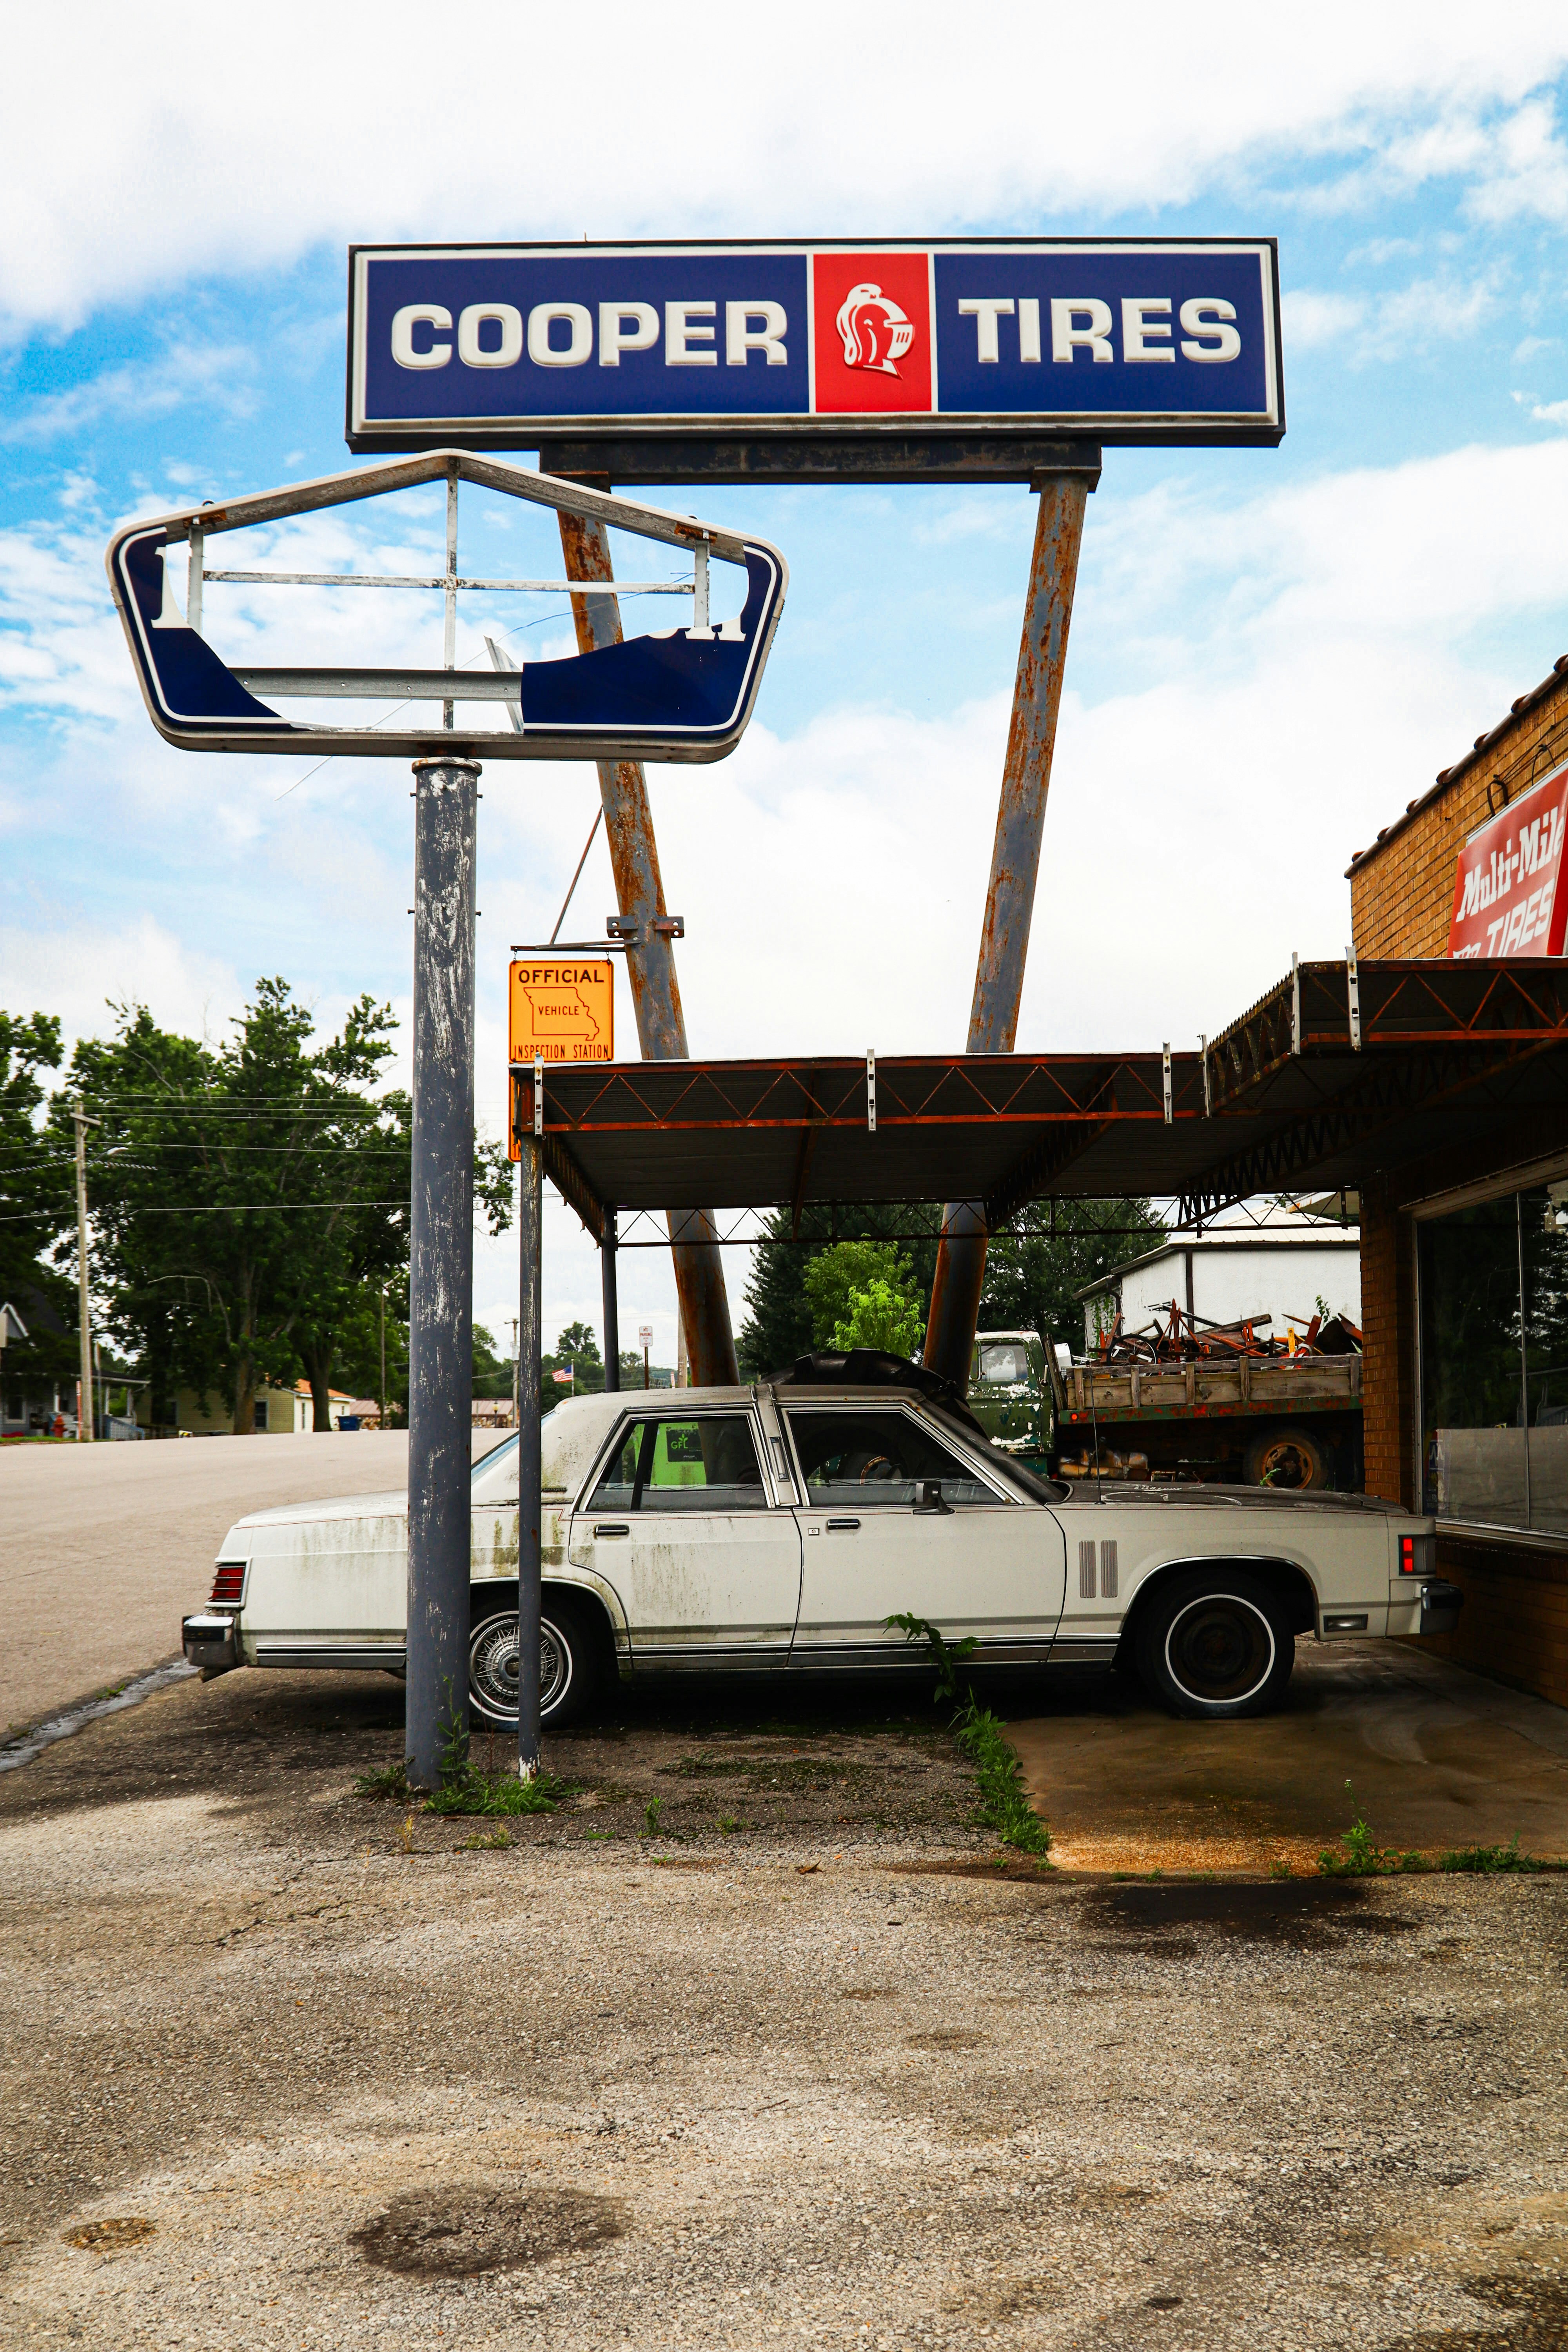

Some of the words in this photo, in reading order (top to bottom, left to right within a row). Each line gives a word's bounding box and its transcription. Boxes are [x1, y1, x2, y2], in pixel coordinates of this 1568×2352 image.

[391, 300, 788, 370] COOPER
[958, 297, 1241, 364] TIRES
[1456, 806, 1564, 923] Multi-Mile
[1487, 878, 1555, 957] TIRES
[519, 969, 604, 983] OFFICIAL
[538, 1005, 579, 1015] VEHICLE
[514, 1045, 565, 1058] INSPECTION
[573, 1044, 608, 1058] STATION
[671, 1437, 688, 1449] GFL
